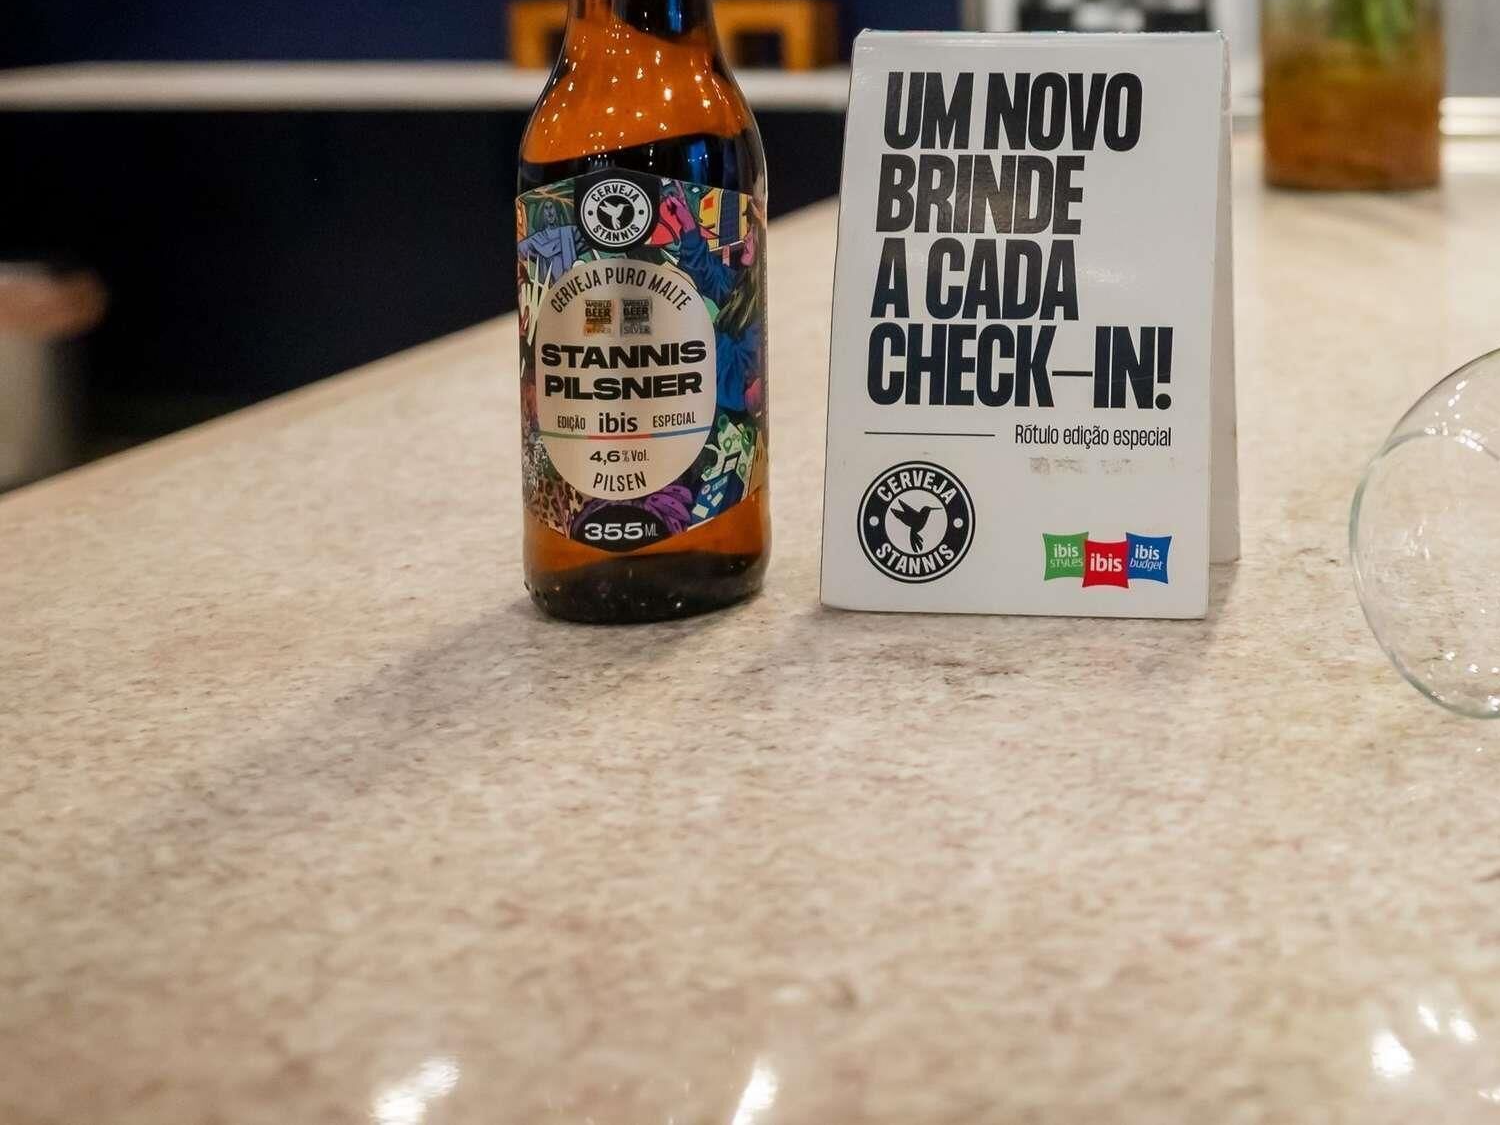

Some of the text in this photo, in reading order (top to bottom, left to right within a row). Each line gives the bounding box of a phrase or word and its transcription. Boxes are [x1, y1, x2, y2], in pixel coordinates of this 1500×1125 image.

[883, 71, 1144, 152] UM NOVO
[590, 184, 641, 204] CERVEJA
[875, 153, 1086, 235] BRINDE
[592, 225, 642, 242] STANNIS
[551, 266, 693, 314] CERVEJA PURO MALTE
[869, 236, 1081, 321] A CADA
[584, 307, 612, 317] BEER
[541, 340, 706, 369] STANNIS
[545, 371, 702, 400] PILSNER
[557, 410, 697, 434] EDIÇÃO ibis ESPECIAL
[1014, 423, 1172, 451] Rótulo edição especial
[592, 470, 647, 493] PILSEN
[876, 469, 959, 507] CERVEJA
[875, 542, 956, 576] STANNIS
[1053, 542, 1080, 558] ibis
[1089, 553, 1123, 573] ibis
[1134, 544, 1161, 560] ibis
[1129, 558, 1164, 573] budget
